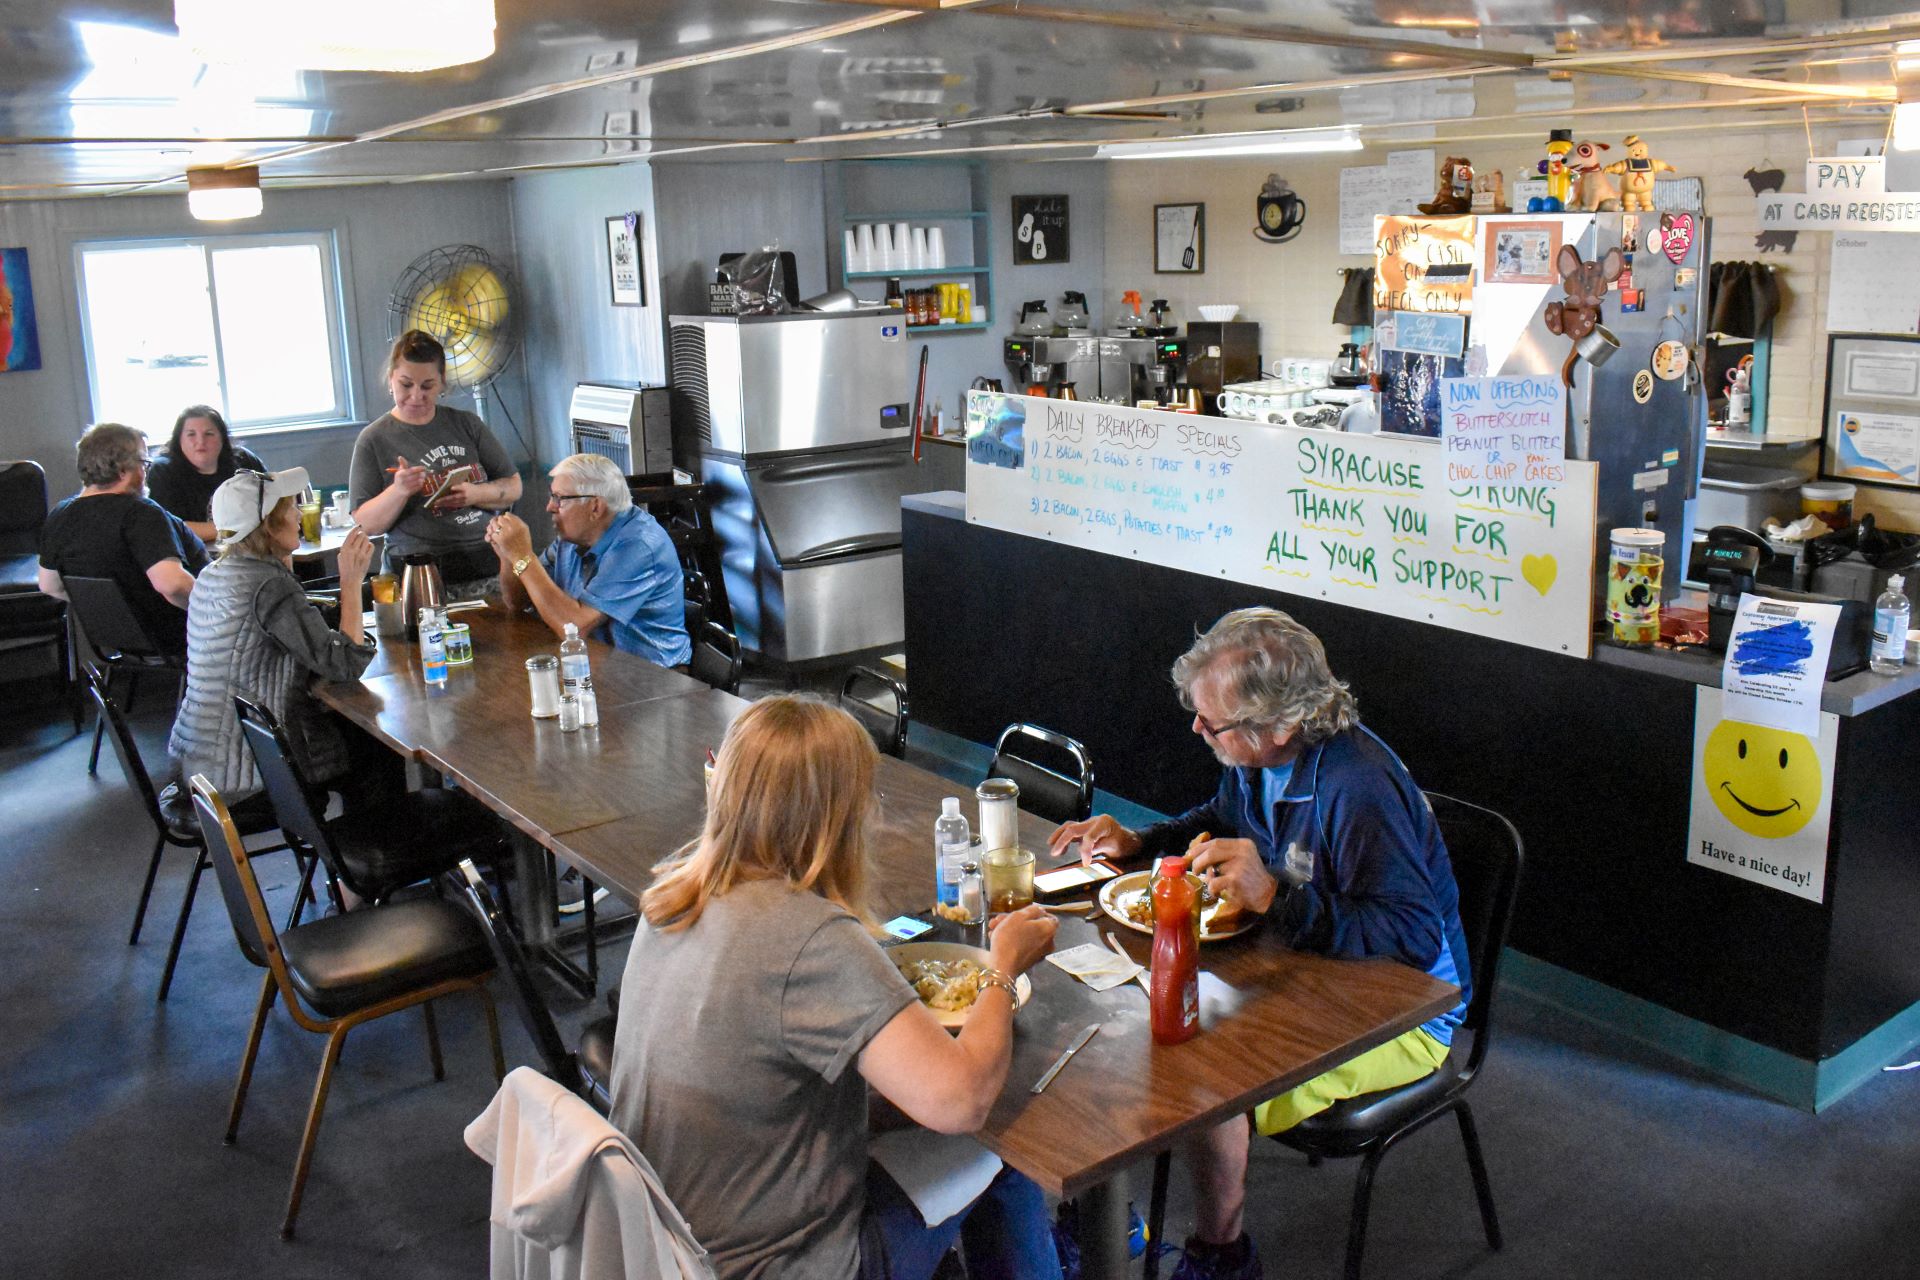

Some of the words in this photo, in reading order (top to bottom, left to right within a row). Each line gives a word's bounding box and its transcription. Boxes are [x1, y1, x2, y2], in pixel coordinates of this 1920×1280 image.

[1817, 164, 1866, 189] PAY
[1764, 203, 1783, 221] AT
[1793, 202, 1842, 221] CASH
[1022, 226, 1028, 237] S
[1668, 227, 1687, 240] LOVE
[1036, 243, 1042, 254] P
[1836, 239, 1868, 248] October
[710, 285, 737, 295] BACO
[1425, 291, 1462, 312] ONLY
[1450, 383, 1480, 402] NOW
[1491, 379, 1558, 400] OFFERING
[1047, 405, 1084, 434] DAILY
[1096, 413, 1166, 443] BREAKFAST
[1176, 424, 1242, 451] SPECIALS
[1451, 412, 1550, 432] BUTTERSCOTCH
[448, 445, 466, 456] YOU
[1447, 435, 1503, 452] PEANUT
[1511, 434, 1562, 451] BUTTER
[1044, 441, 1052, 459] 2
[1092, 448, 1101, 464] 2
[1151, 457, 1184, 472] TOAST
[1298, 438, 1424, 489] SYRACUSE
[1487, 451, 1504, 464] OR
[1485, 463, 1517, 480] CHIP
[1524, 464, 1564, 481] CAKES
[1043, 500, 1049, 513] 2
[1085, 507, 1094, 522] 2
[1124, 509, 1163, 535] POTATOES
[1175, 525, 1205, 543] TOAST
[1287, 489, 1365, 526] THANK
[1384, 504, 1427, 536] YOU
[1455, 514, 1507, 555] FOR
[1266, 531, 1308, 564] ALL
[1321, 540, 1377, 583] YOUR
[1392, 549, 1513, 602] SUPPORT
[1701, 840, 1735, 863] Have
[1738, 855, 1746, 867] a
[1749, 857, 1778, 876] nice
[1782, 865, 1811, 887] day!
